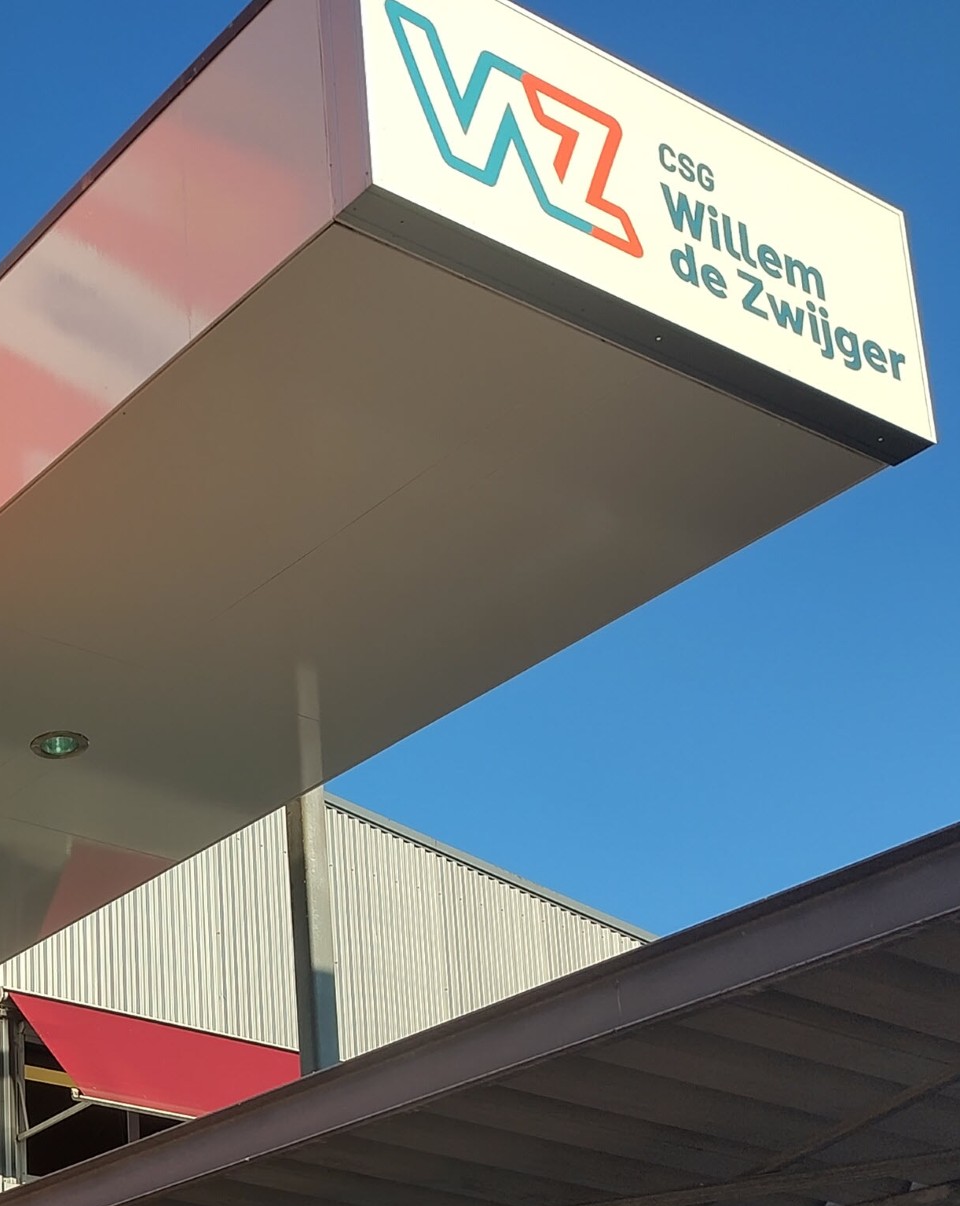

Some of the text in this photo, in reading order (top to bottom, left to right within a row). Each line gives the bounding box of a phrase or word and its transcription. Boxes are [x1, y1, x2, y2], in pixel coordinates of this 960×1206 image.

[658, 143, 715, 192] CSG
[659, 181, 826, 302] Willem
[669, 242, 907, 383] de Zwijger
